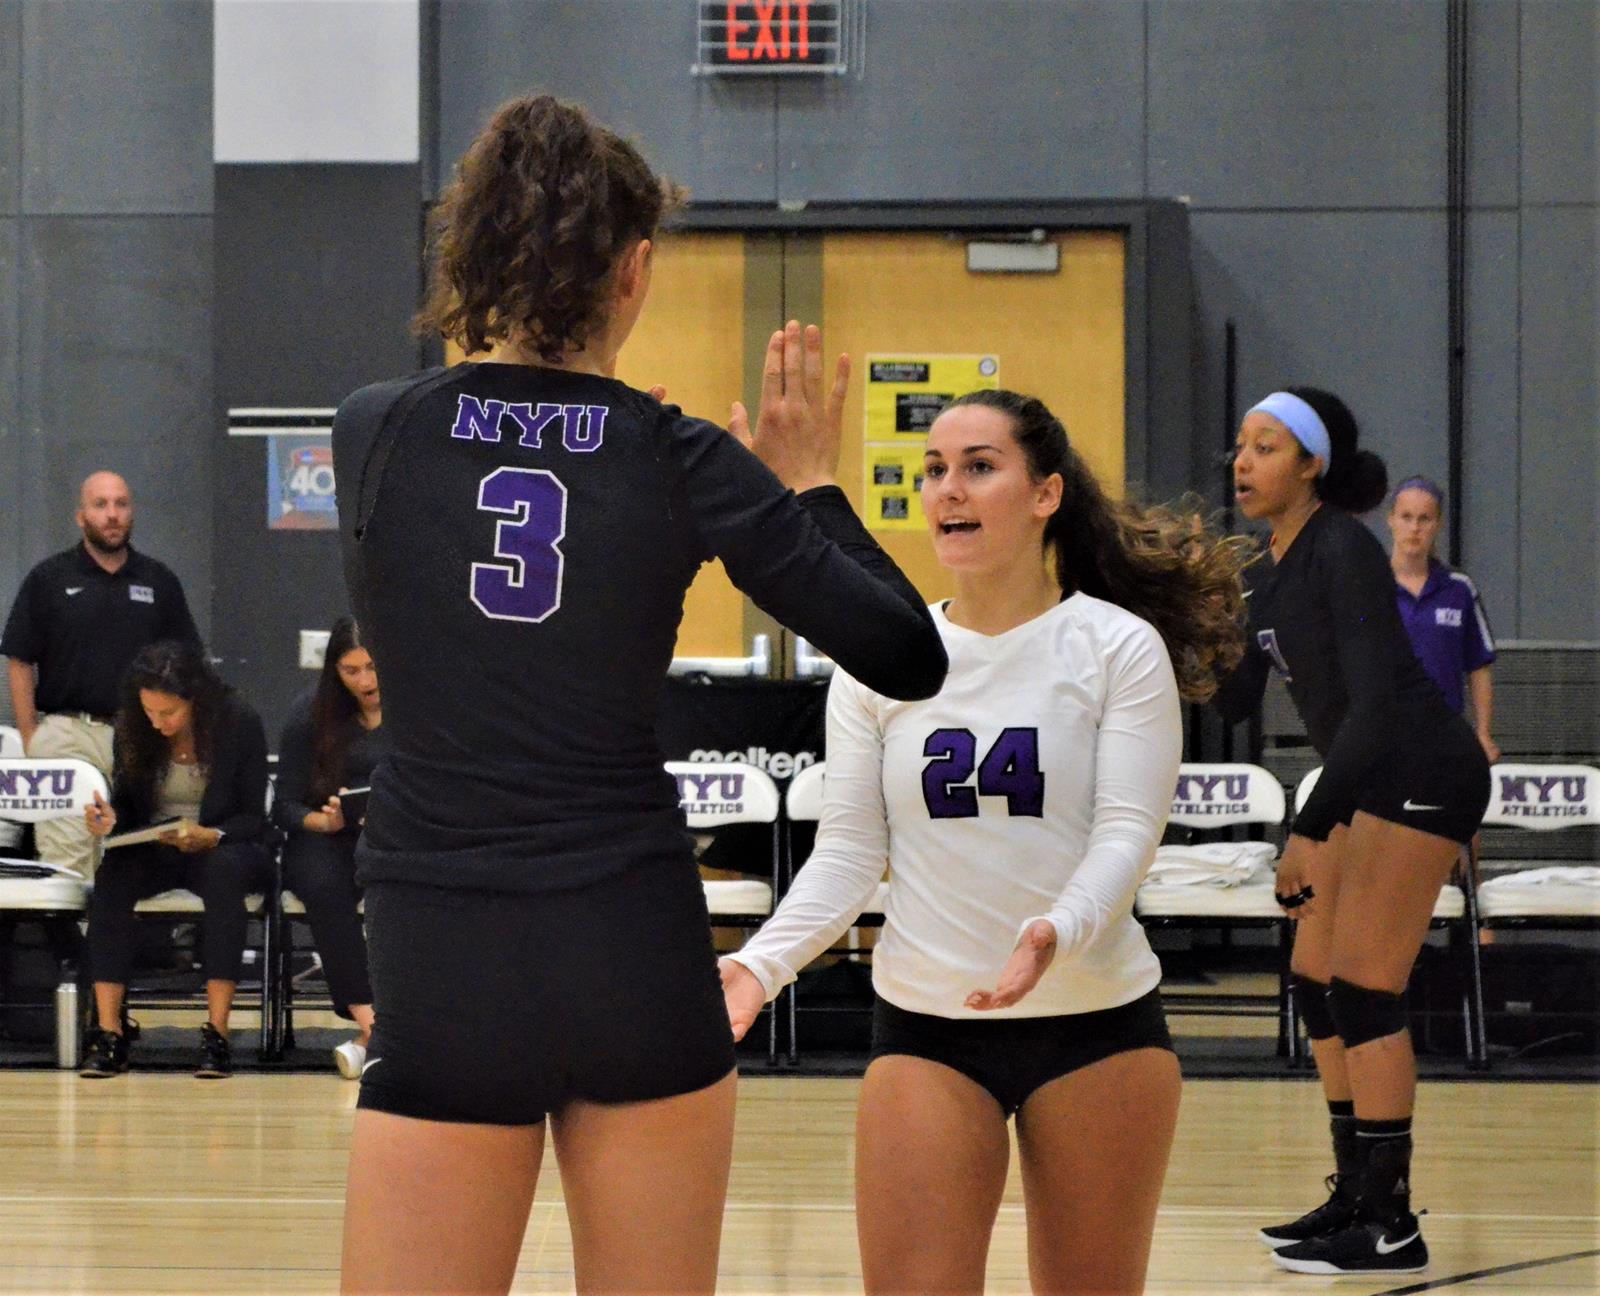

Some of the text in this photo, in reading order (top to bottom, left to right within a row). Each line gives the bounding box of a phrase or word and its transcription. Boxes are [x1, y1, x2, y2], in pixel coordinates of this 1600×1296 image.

[727, 0, 811, 60] EXIT
[451, 393, 609, 452] NYU
[470, 466, 568, 623] 3
[0, 769, 75, 795] NYU
[921, 727, 1045, 819] 24
[1500, 775, 1586, 802] NYU
[0, 799, 74, 809] THLETICS
[681, 803, 744, 814] HLETICS
[1502, 805, 1588, 816] ATHLETICS
